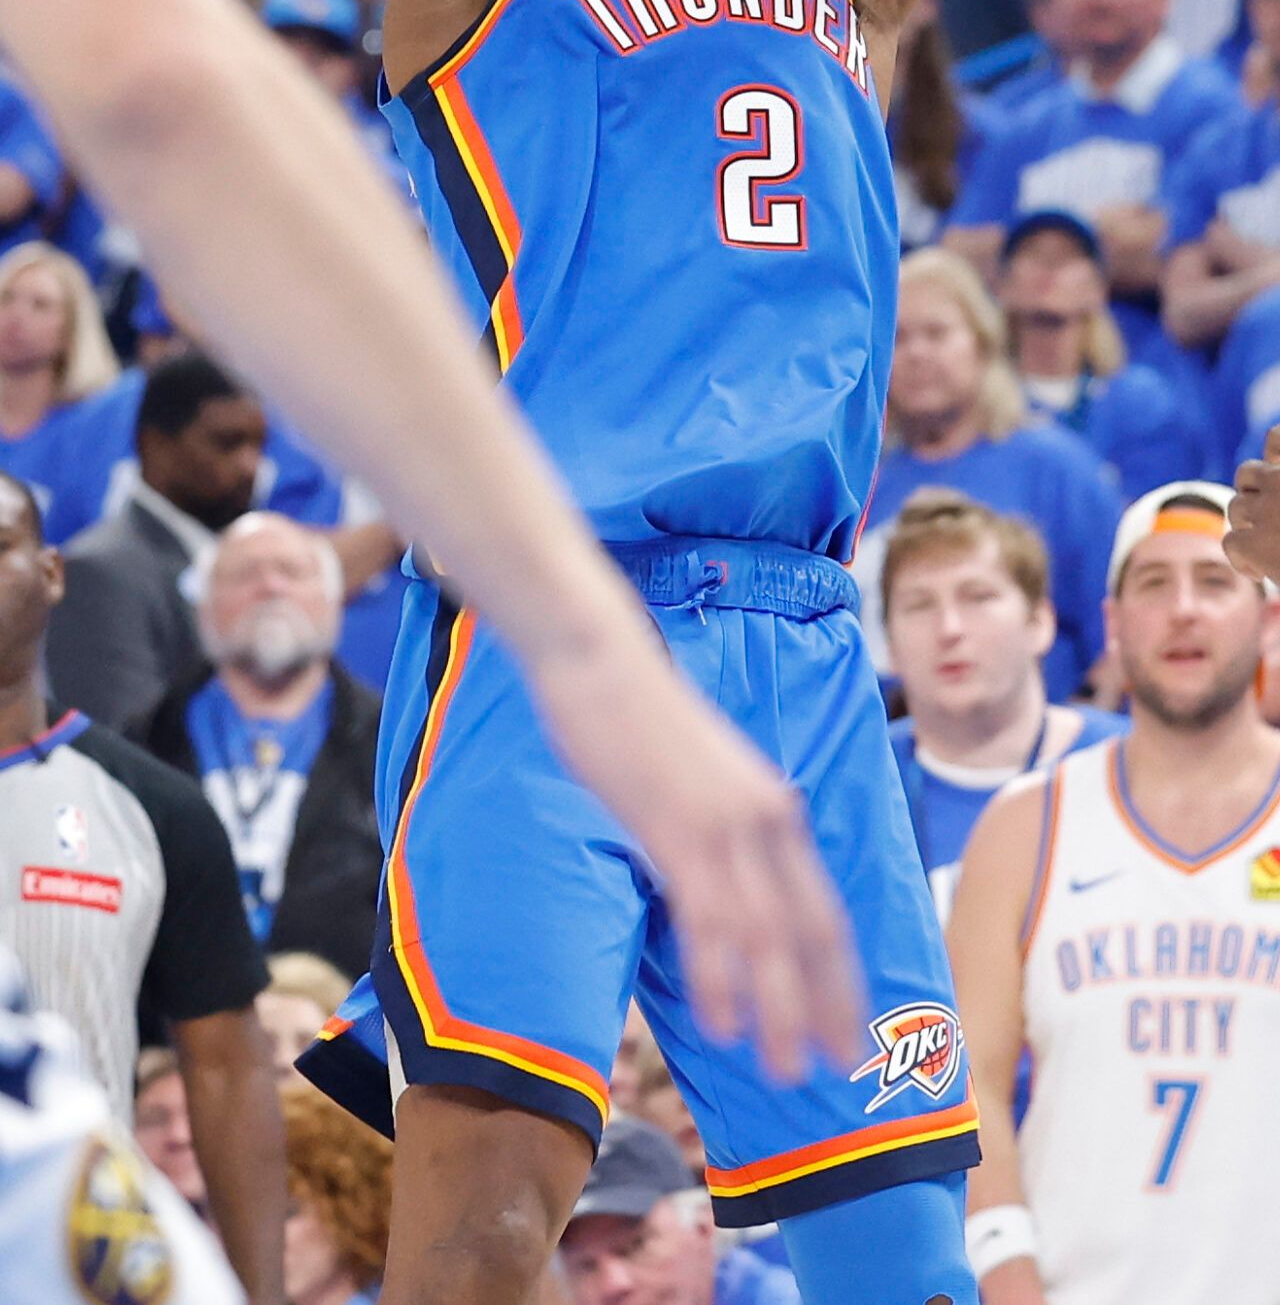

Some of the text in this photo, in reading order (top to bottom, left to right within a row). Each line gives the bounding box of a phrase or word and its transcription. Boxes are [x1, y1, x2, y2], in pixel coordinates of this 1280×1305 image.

[716, 83, 808, 252] 2
[884, 1021, 948, 1085] OKC
[1124, 995, 1237, 1056] CITY
[1143, 1071, 1212, 1196] 7
